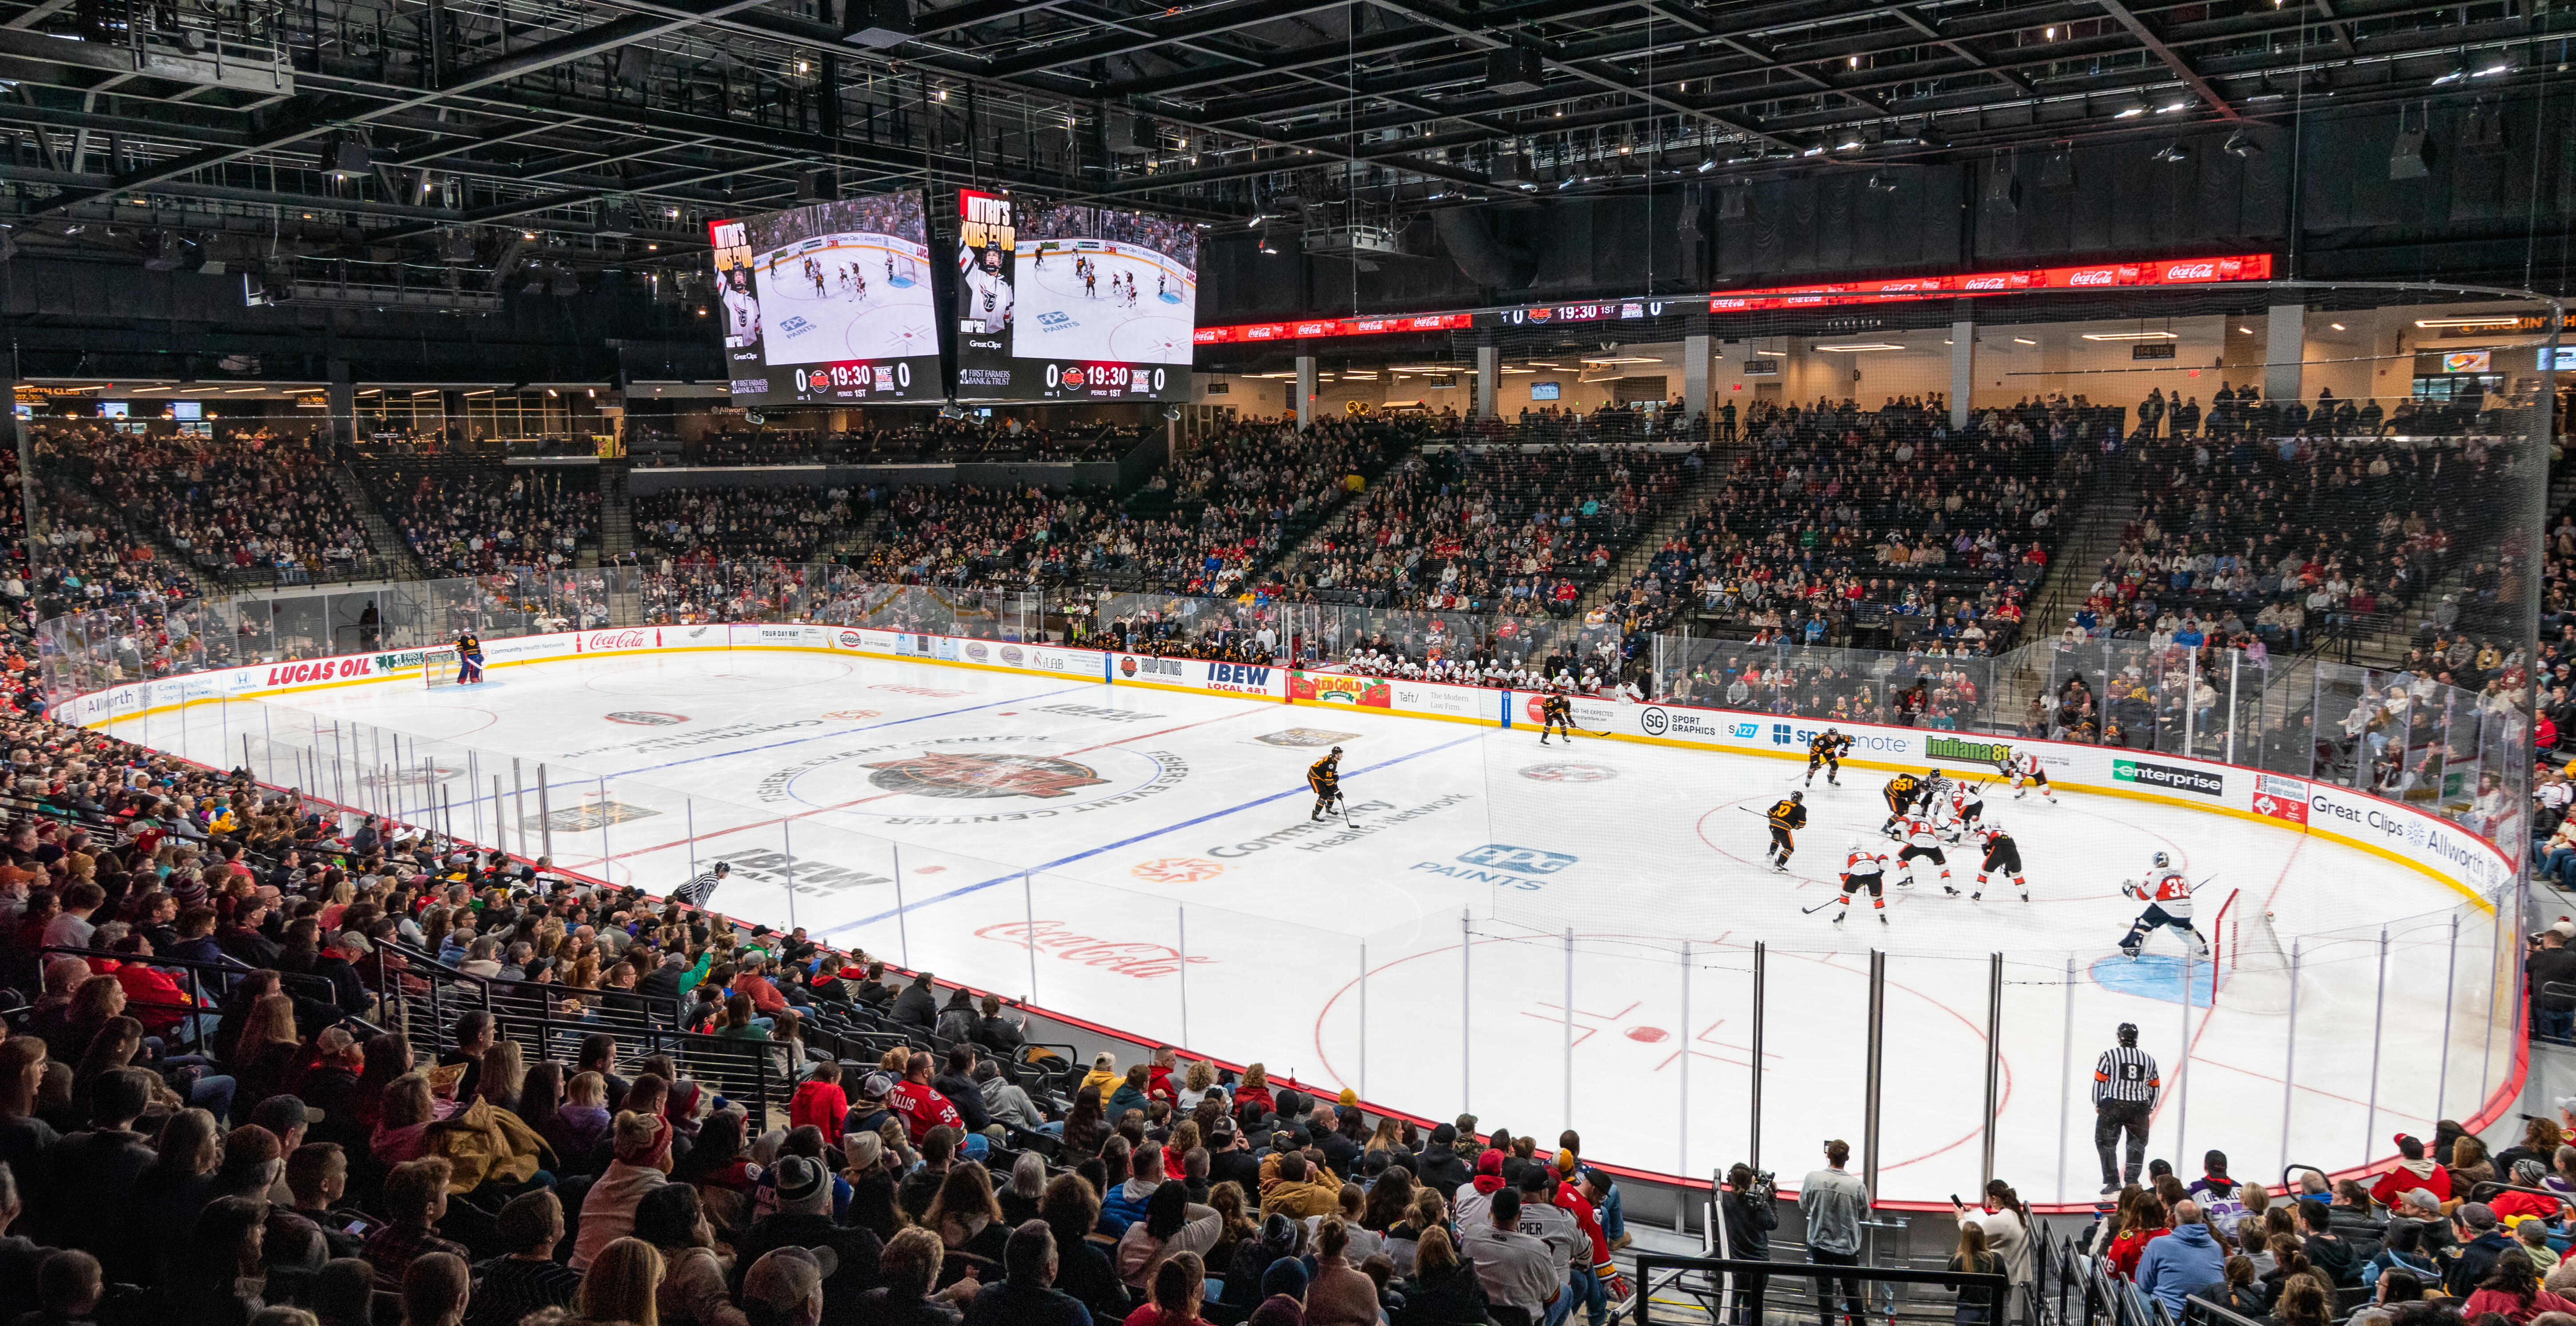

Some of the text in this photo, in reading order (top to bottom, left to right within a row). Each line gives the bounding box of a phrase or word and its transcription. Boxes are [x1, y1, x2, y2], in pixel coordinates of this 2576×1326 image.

[968, 196, 1010, 226] NITRO'S
[714, 223, 747, 249] NITRO'S
[962, 221, 987, 249] KIDS
[714, 248, 733, 271] KIDS
[1142, 250, 1159, 260] Allworth
[2070, 270, 2114, 286] Coca-Cola
[2168, 264, 2215, 280] Coca-Cola
[1039, 312, 1066, 324] PPG
[1414, 316, 1440, 327] Coca-Cola
[1558, 305, 1598, 320] 19:30
[1600, 306, 1615, 315] 1ST
[781, 316, 806, 331] PPG
[786, 324, 817, 339] PAINTS
[1043, 321, 1080, 333] PAINTS
[1248, 327, 1271, 338] Coca-Cola
[1298, 324, 1322, 334] Coca-Cola
[970, 340, 1002, 350] Great Clips
[796, 369, 807, 392] 0
[830, 365, 870, 386] 19:30
[898, 363, 910, 387] 0
[1047, 364, 1059, 388] 0
[1062, 373, 1083, 384] FUEL
[1087, 366, 1128, 386] 19:30
[1154, 368, 1165, 391] 0
[590, 630, 647, 650] Coca-Cola
[840, 634, 861, 644] Glidden
[491, 646, 522, 655] Community
[404, 658, 423, 666] BANK
[1043, 658, 1063, 669] iLAB
[1142, 658, 1182, 676] GROUP OUTINGS
[267, 662, 335, 686] LUCAS
[340, 658, 371, 678] OIL
[1207, 663, 1270, 686] IBEW
[1207, 683, 1242, 692] LOCAL
[1312, 678, 1363, 692] RED GOLD
[1444, 693, 1469, 702] Modern
[609, 711, 677, 726] Glidden
[1646, 714, 1664, 728] SG
[1672, 715, 1701, 725] SPORT
[636, 720, 824, 754] Community
[679, 722, 756, 738] Health
[1672, 724, 1716, 735] GRAPHICS
[1796, 729, 1906, 752] spenote
[1926, 735, 2012, 762] Indiana81
[762, 735, 1049, 804] FISHERS EVENT CENTER
[2119, 765, 2221, 791] enterprise
[884, 750, 1189, 825] FISHERS EVENT CENTER
[1295, 791, 1475, 852] Health Network
[2312, 795, 2403, 837] Great Clips
[1458, 845, 1578, 874] PPG
[2427, 830, 2484, 877] Allworth
[711, 848, 894, 889] IBEW
[1409, 861, 1548, 891] PAINTS
[974, 920, 1224, 979] Coca-Cola
[2128, 1066, 2137, 1080] 8
[939, 1105, 958, 1123] 39
